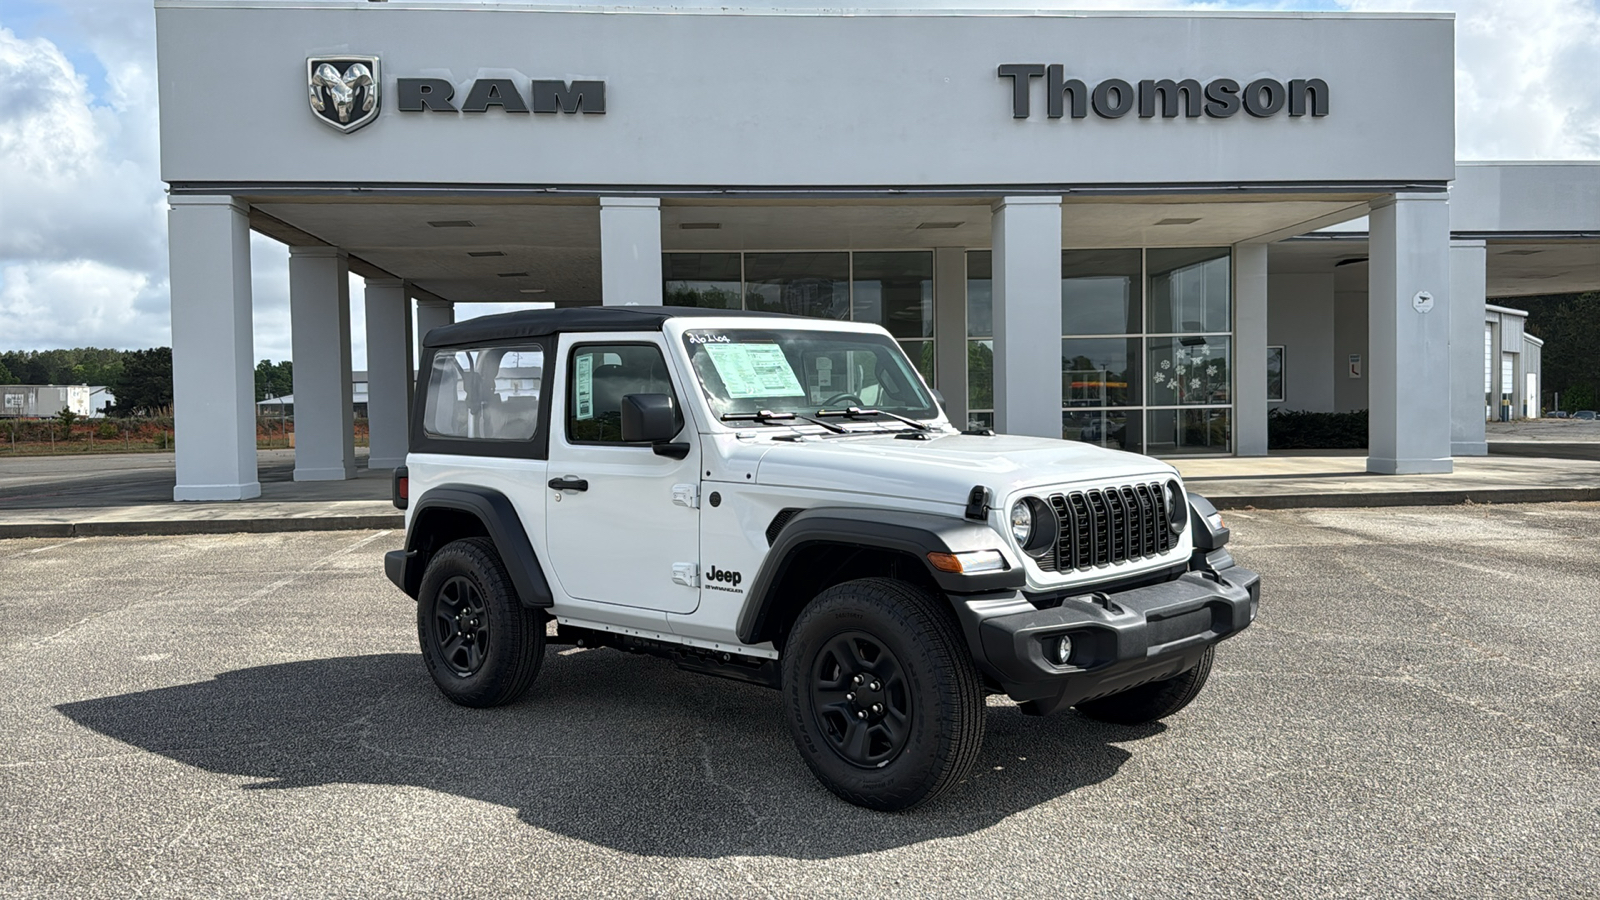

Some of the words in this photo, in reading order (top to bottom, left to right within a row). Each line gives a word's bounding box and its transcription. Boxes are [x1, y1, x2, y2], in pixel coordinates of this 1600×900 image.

[397, 77, 606, 114] RAM
[997, 64, 1330, 119] Thomson
[706, 565, 742, 587] Jeep
[711, 585, 744, 594] WRANGLER
